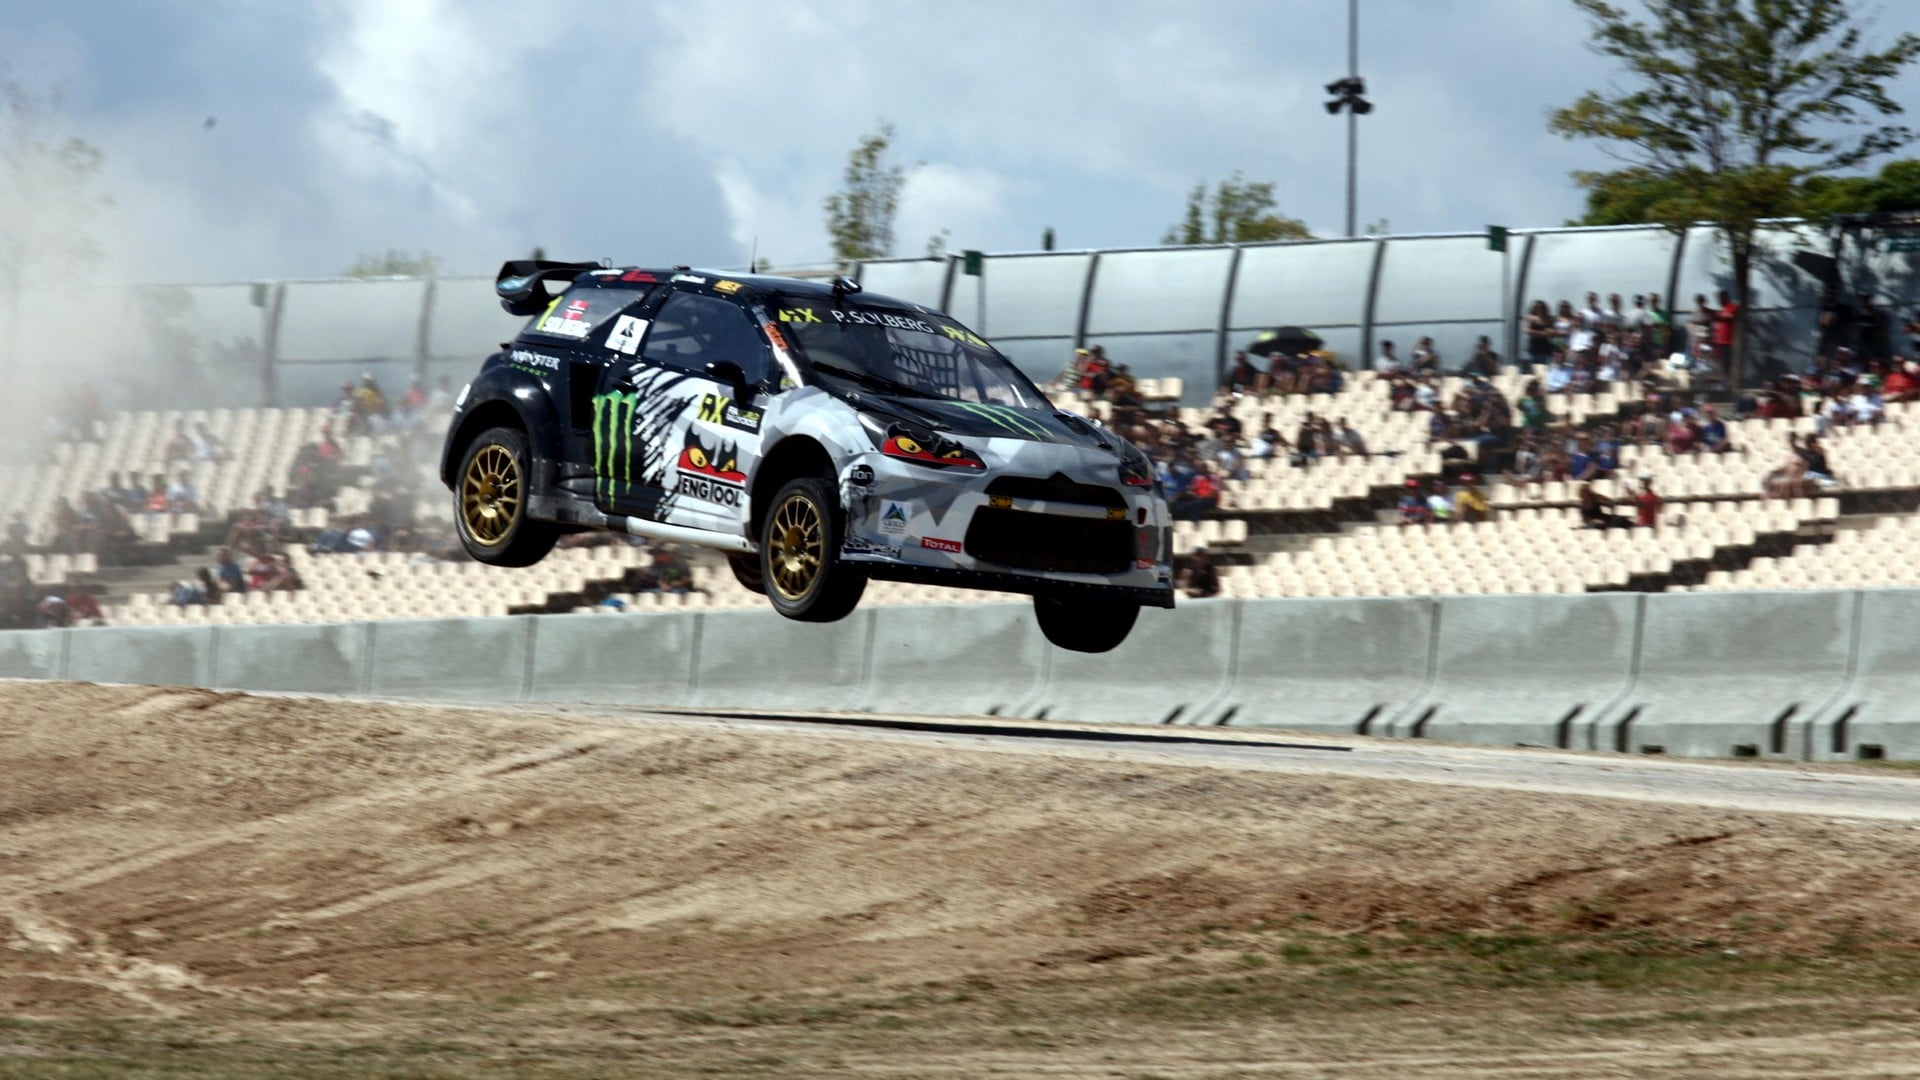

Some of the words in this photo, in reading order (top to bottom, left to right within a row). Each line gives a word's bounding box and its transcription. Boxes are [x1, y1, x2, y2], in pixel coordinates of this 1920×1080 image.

[510, 350, 560, 371] MONSTER
[697, 393, 730, 425] RX
[924, 538, 959, 552] TOTAL
